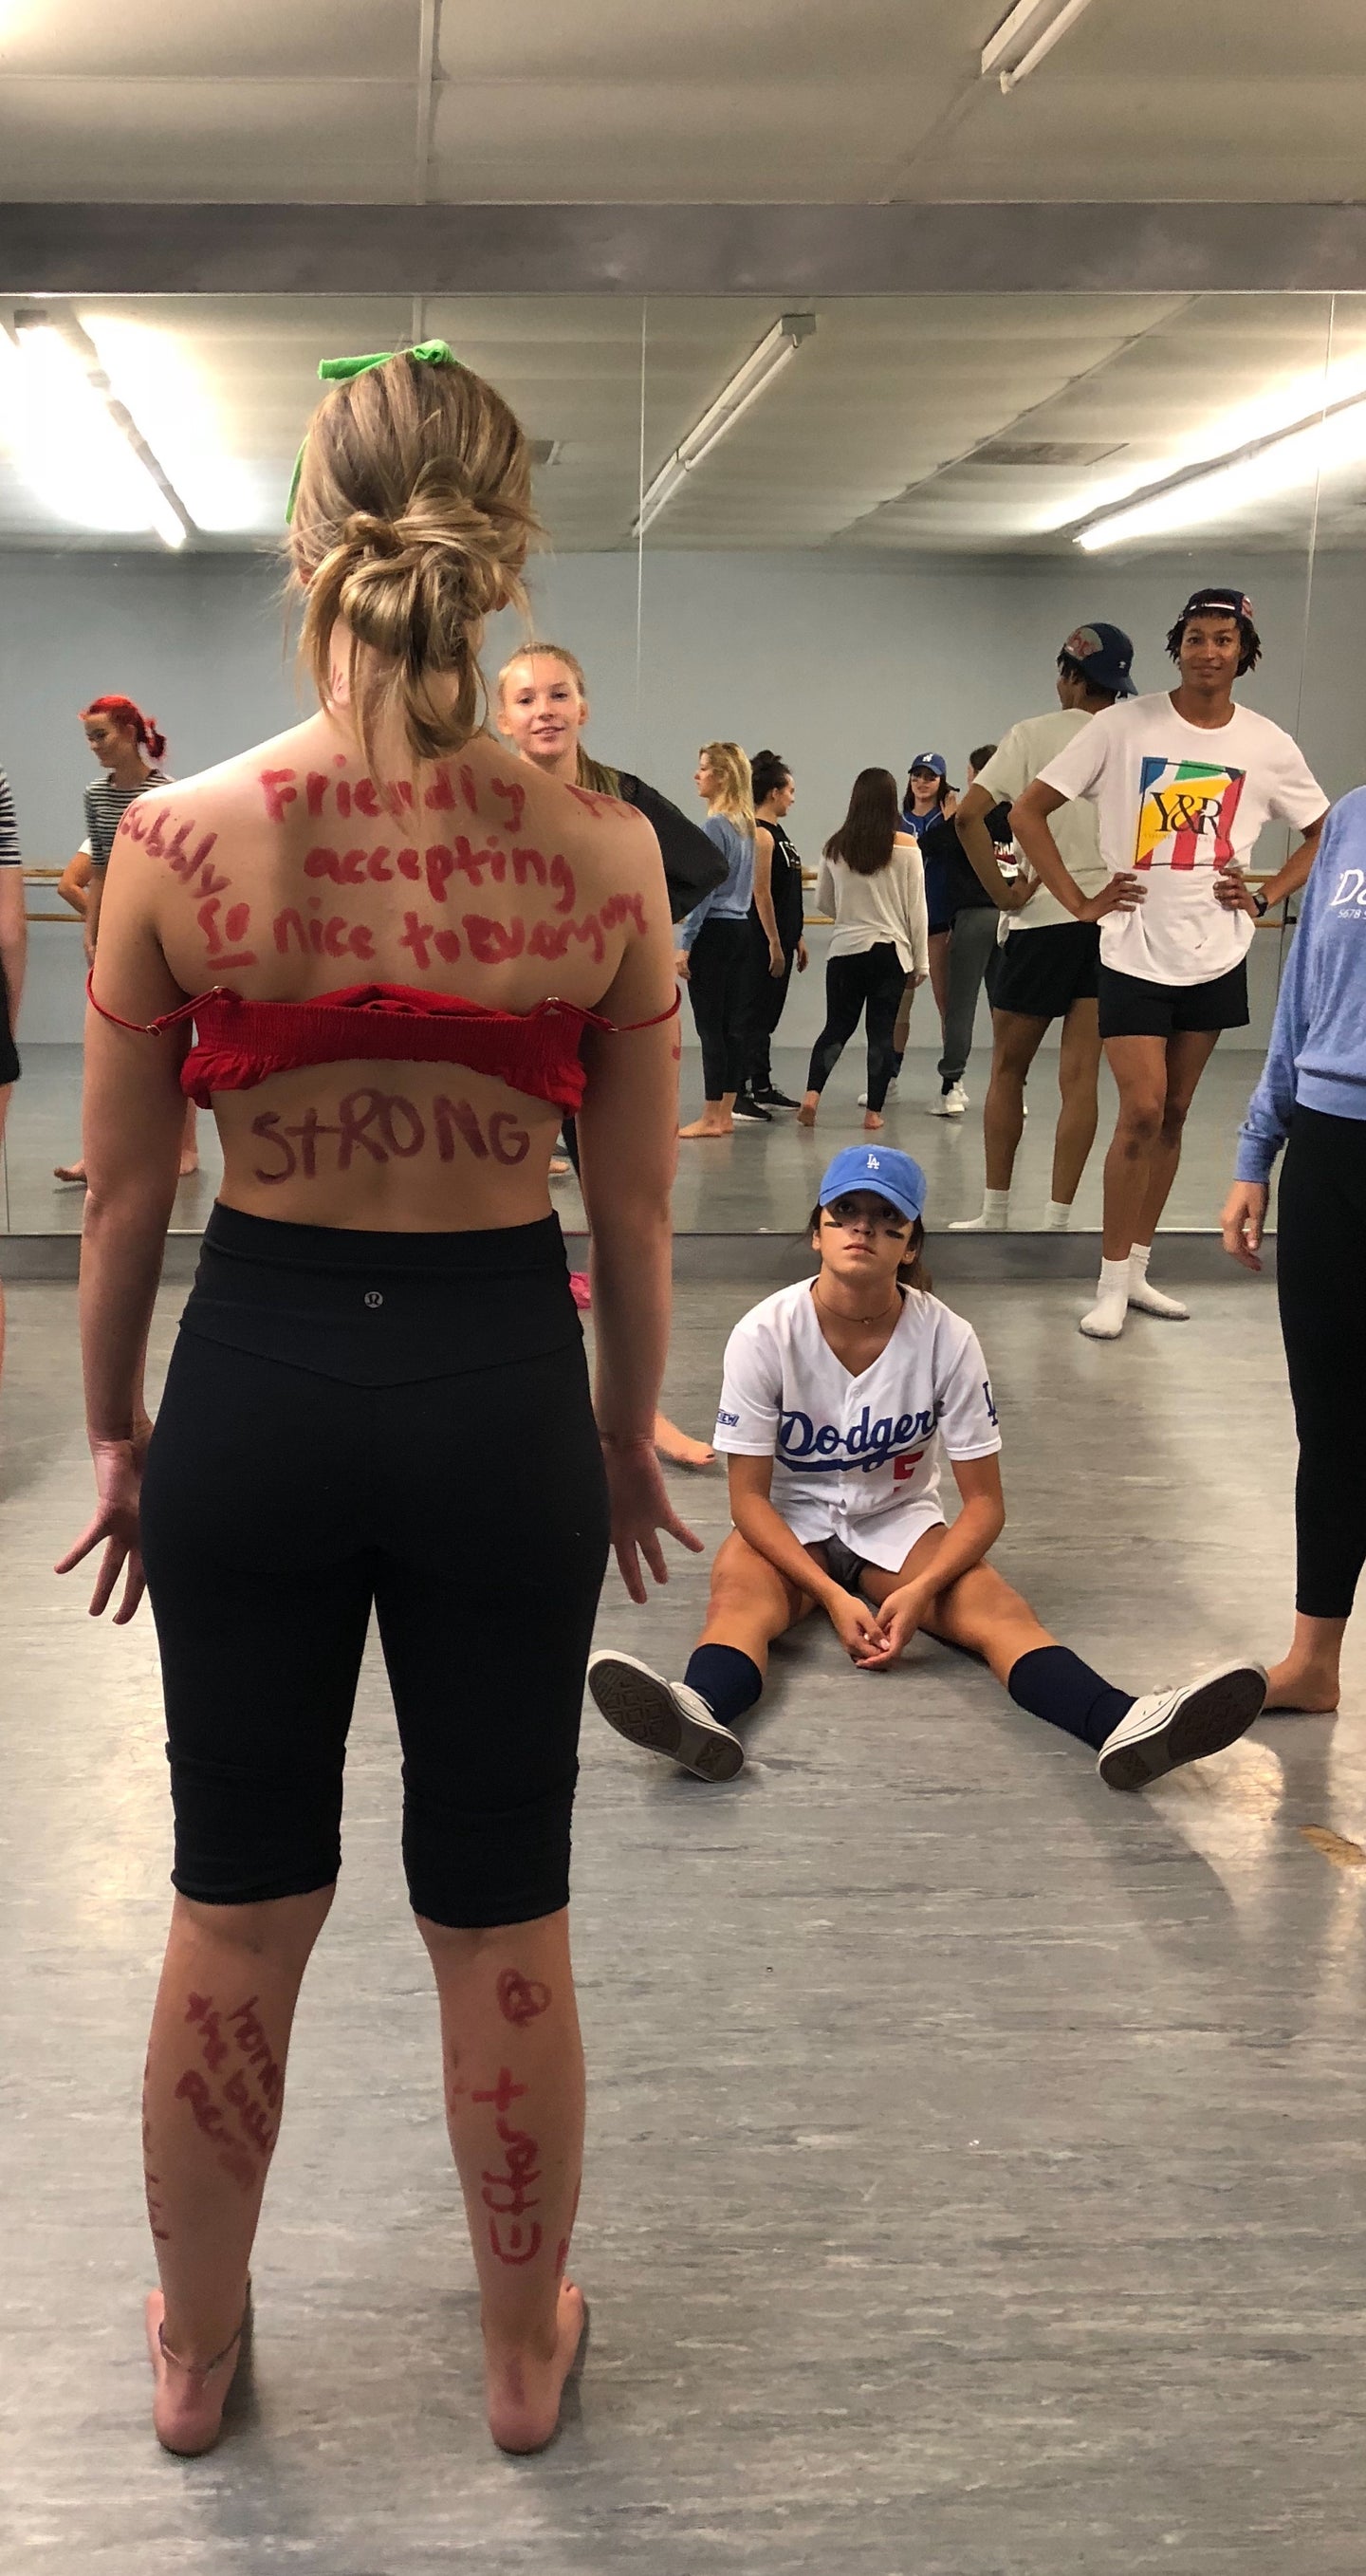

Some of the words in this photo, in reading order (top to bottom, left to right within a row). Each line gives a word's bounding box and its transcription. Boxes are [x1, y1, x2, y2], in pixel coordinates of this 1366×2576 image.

[259, 754, 526, 832] Friendly
[1150, 792, 1222, 839] Y&R
[304, 836, 576, 914] accepting
[273, 897, 376, 960] nice
[867, 1153, 879, 1170] LA
[780, 1406, 938, 1473] Dodger
